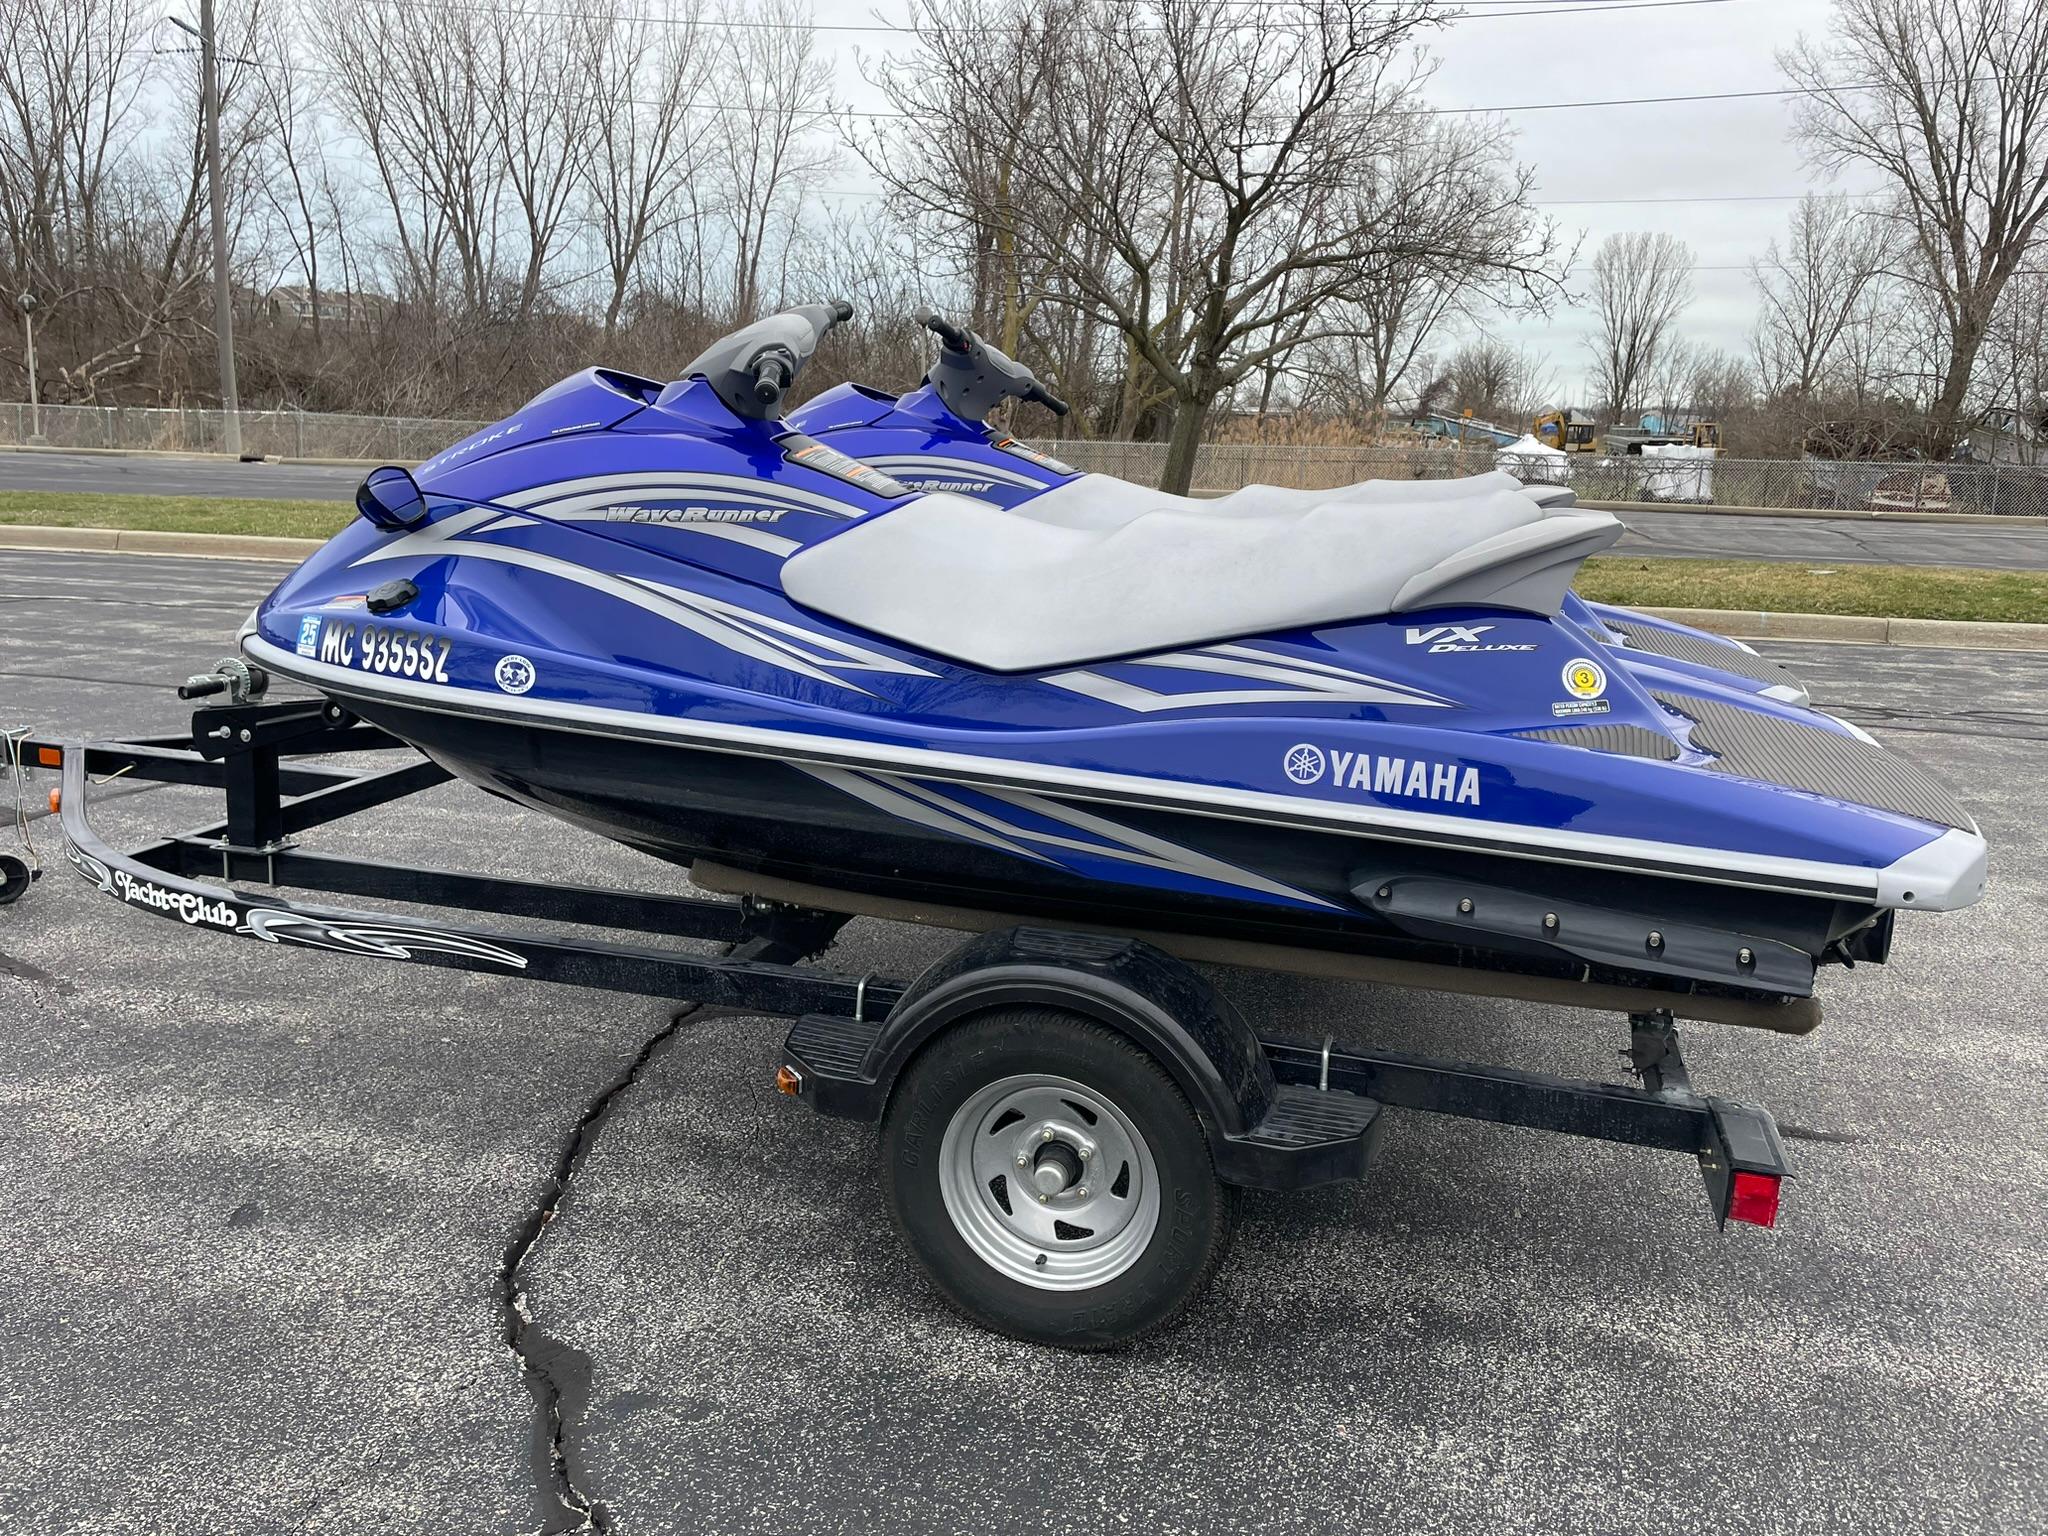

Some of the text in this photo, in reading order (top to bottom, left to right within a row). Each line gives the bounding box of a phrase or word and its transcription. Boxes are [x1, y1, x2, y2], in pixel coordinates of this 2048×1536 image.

[900, 480, 995, 492] eRunner
[606, 506, 790, 523] WaveRunner
[301, 622, 318, 645] 25
[1405, 625, 1496, 645] VX
[321, 620, 452, 683] MC 9355SZ
[1580, 672, 1589, 684] 3
[1330, 749, 1481, 806] YAMAHA
